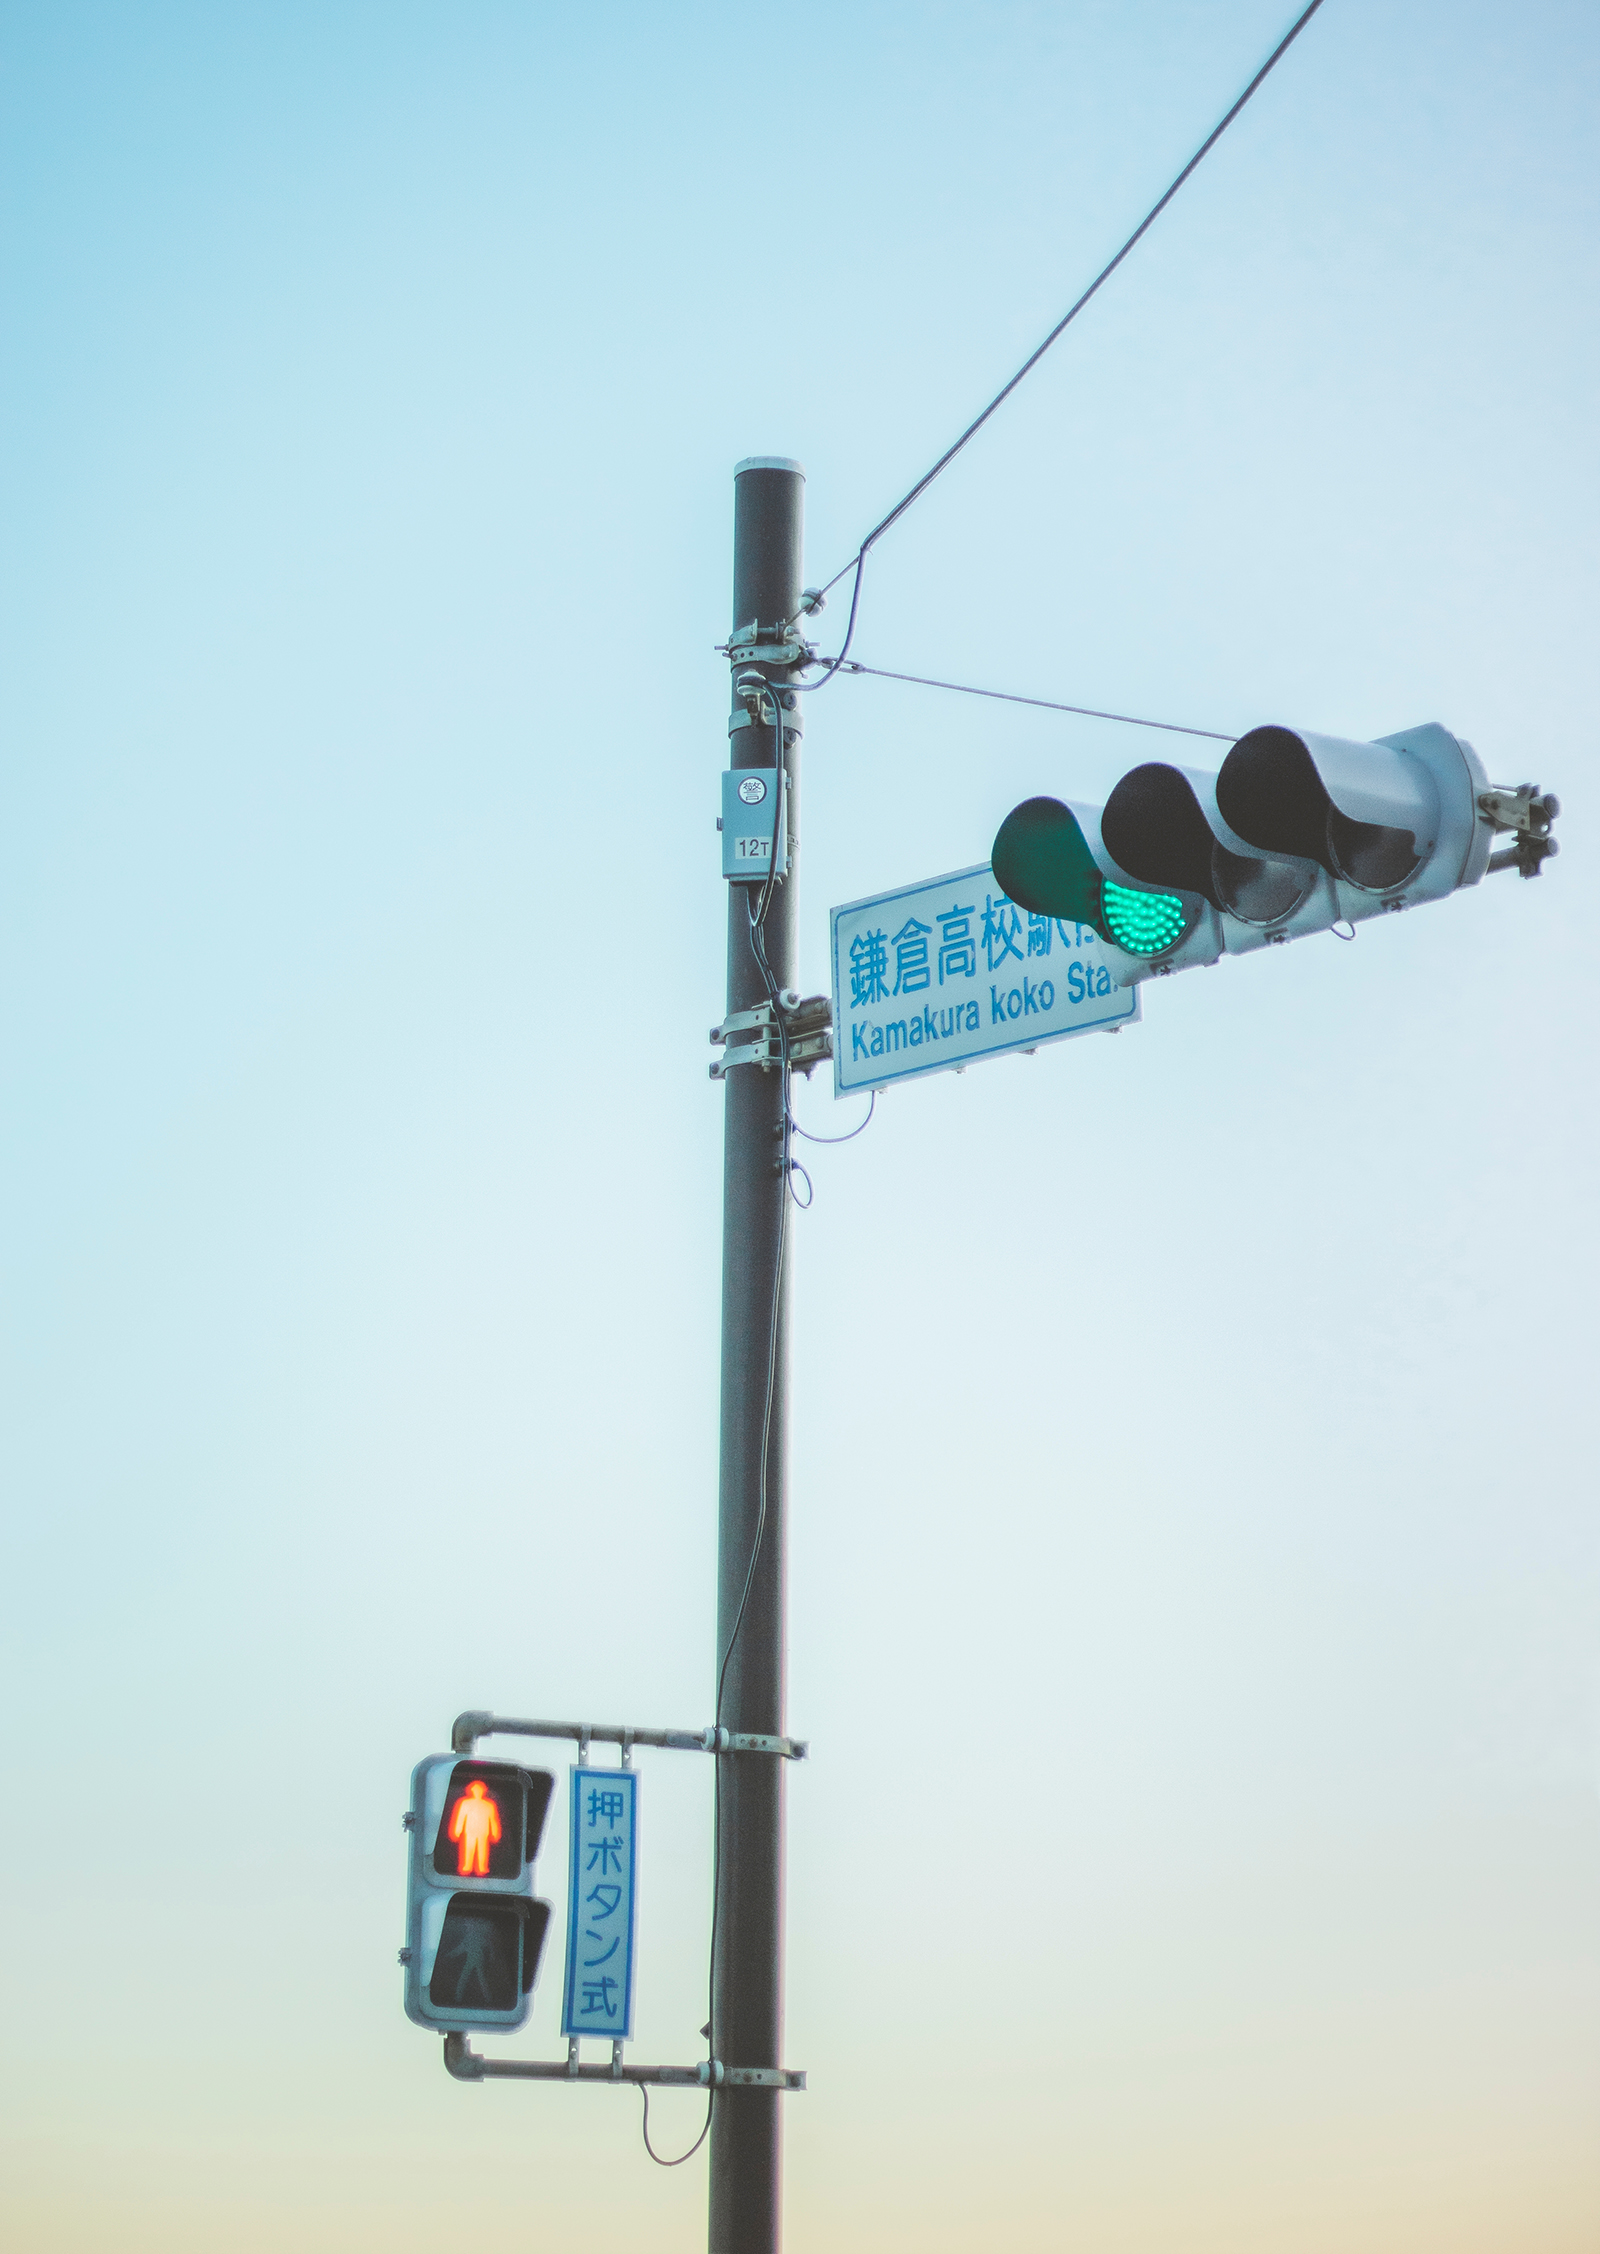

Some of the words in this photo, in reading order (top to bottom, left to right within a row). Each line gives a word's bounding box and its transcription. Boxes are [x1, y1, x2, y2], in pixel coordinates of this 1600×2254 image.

[739, 839, 769, 857] 12T
[849, 893, 1094, 1009] 鎌倉高校駅
[852, 1000, 980, 1062] Kamakura
[990, 976, 1055, 1024] koko
[580, 1788, 624, 2018] 押ボタン式
